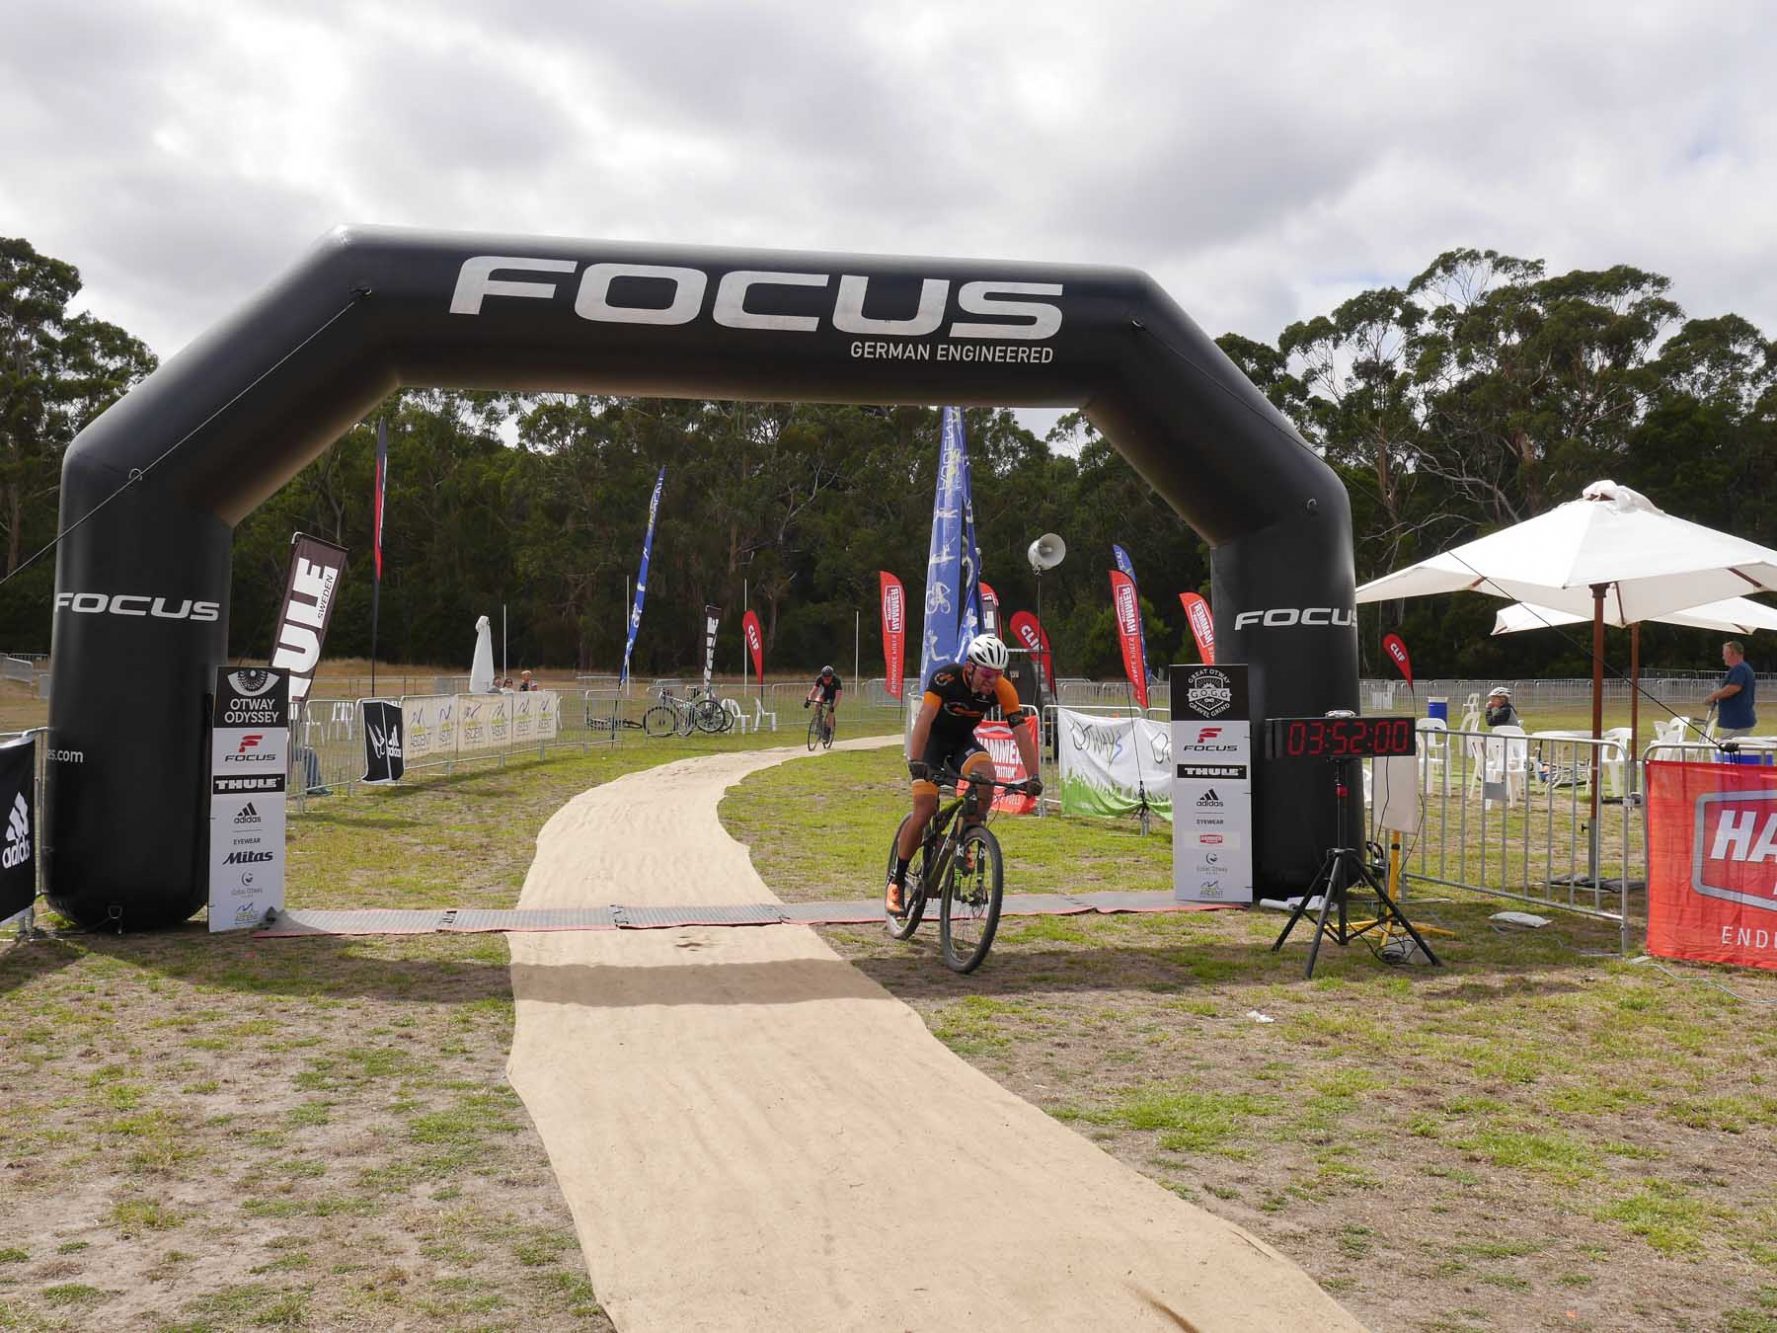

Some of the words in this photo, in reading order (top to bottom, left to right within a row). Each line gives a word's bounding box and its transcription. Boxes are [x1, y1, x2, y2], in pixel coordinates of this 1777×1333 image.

[449, 255, 1064, 341] FOCUS
[850, 341, 931, 360] GERMAN
[936, 344, 1055, 364] ENGINEERED
[317, 574, 334, 621] SWEDEN
[55, 592, 220, 622] FOCUS
[271, 557, 338, 703] ULE
[748, 625, 760, 651] CLIF
[1390, 643, 1405, 662] CLIF
[1188, 669, 1208, 683] GREAT
[1209, 668, 1231, 683] OTWAY
[230, 698, 276, 710] OTWAY
[1188, 702, 1210, 718] GRAVEL
[1210, 702, 1231, 717] GRIND
[224, 711, 279, 723] ODYSSEY
[1287, 721, 1409, 756] 03:52:00
[225, 753, 277, 762] FOCUS
[1184, 767, 1240, 776] THULE
[215, 778, 278, 790] THULE
[233, 816, 261, 824] adidas
[2, 834, 30, 869] adids
[222, 850, 273, 865] Mitas
